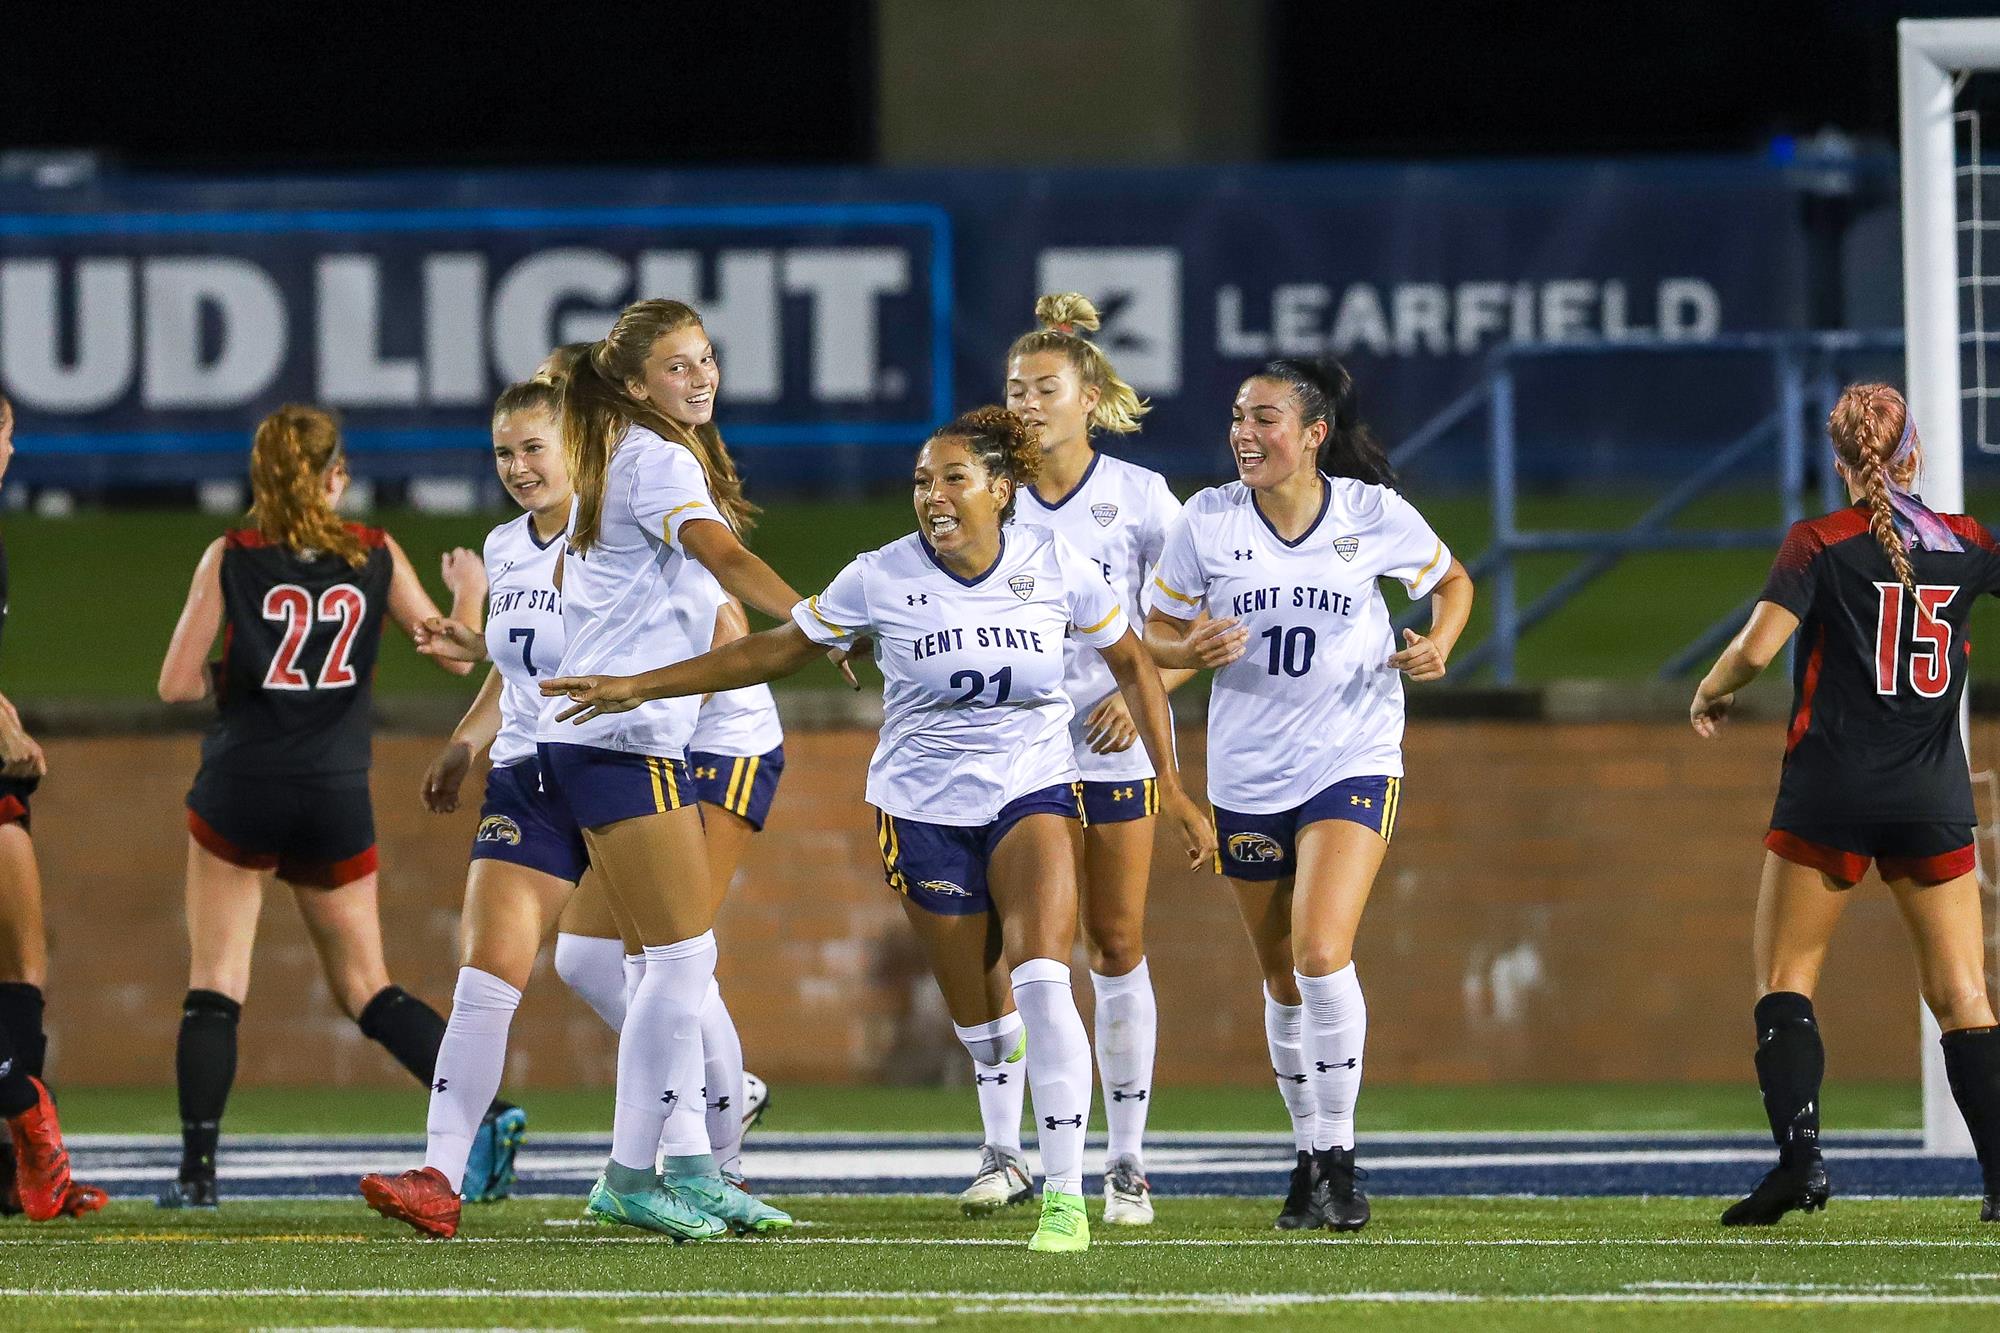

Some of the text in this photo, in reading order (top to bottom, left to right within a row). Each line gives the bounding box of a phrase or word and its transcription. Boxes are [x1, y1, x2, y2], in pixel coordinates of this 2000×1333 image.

[313, 247, 907, 404] LIGHT
[1215, 279, 1720, 356] LEARFIELD
[1233, 586, 1351, 617] KENT STATE
[262, 583, 367, 691] 22
[509, 628, 538, 677] 7
[913, 628, 963, 661] KENT
[976, 627, 1044, 653] STATE
[1261, 625, 1316, 678] 10
[1872, 581, 1961, 698] 15
[949, 666, 1012, 708] 21
